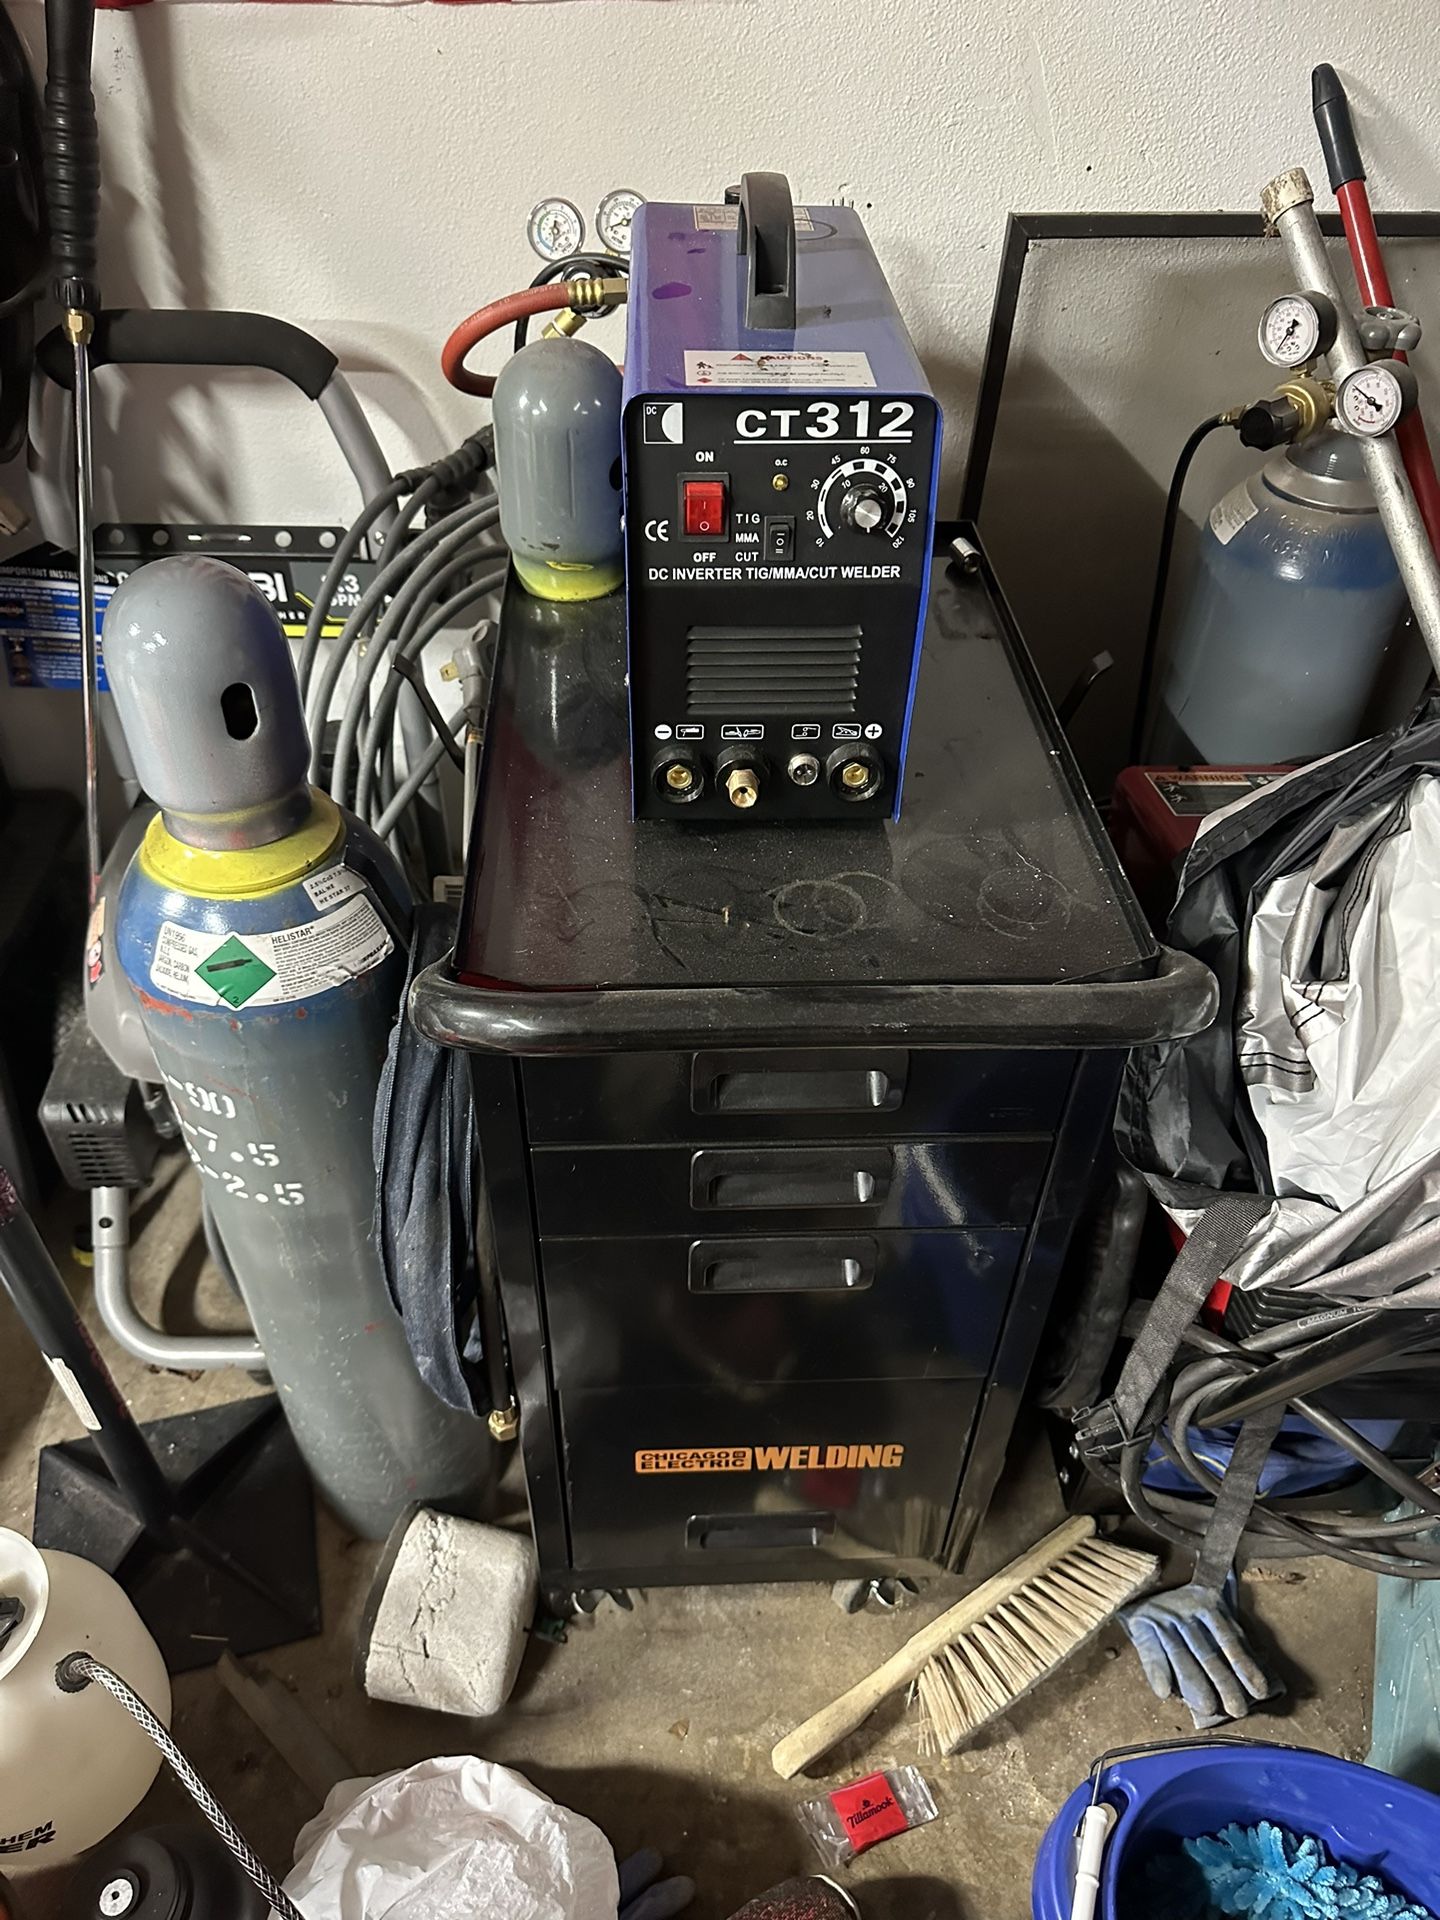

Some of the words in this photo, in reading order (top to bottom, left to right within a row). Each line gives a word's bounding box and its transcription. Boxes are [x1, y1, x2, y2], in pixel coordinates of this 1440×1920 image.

[646, 406, 657, 416] DC
[735, 400, 915, 439] CT312
[860, 446, 870, 454] 60
[695, 451, 714, 463] ON
[831, 455, 841, 465] 45
[886, 453, 897, 464] 75
[810, 479, 820, 490] 30
[841, 479, 851, 489] 10
[878, 482, 888, 493] 20
[906, 477, 915, 489] 90
[735, 513, 761, 524] TIG
[806, 510, 814, 521] 20
[907, 509, 917, 523] 105
[735, 531, 760, 544] MMA
[815, 537, 825, 547] 10
[892, 536, 905, 549] 120
[693, 552, 716, 563] OFF
[735, 552, 759, 562] CUT
[648, 569, 668, 581] DC
[672, 568, 742, 580] INVERTER
[744, 567, 837, 580] TIG/MMA/CUT
[841, 566, 901, 578] WELDER
[233, 996, 239, 1004] 2
[641, 1451, 729, 1461] CHICAGO
[754, 1444, 904, 1470] WELDING
[641, 1459, 744, 1470] ELECTRIC
[847, 1797, 893, 1828] Tillamook
